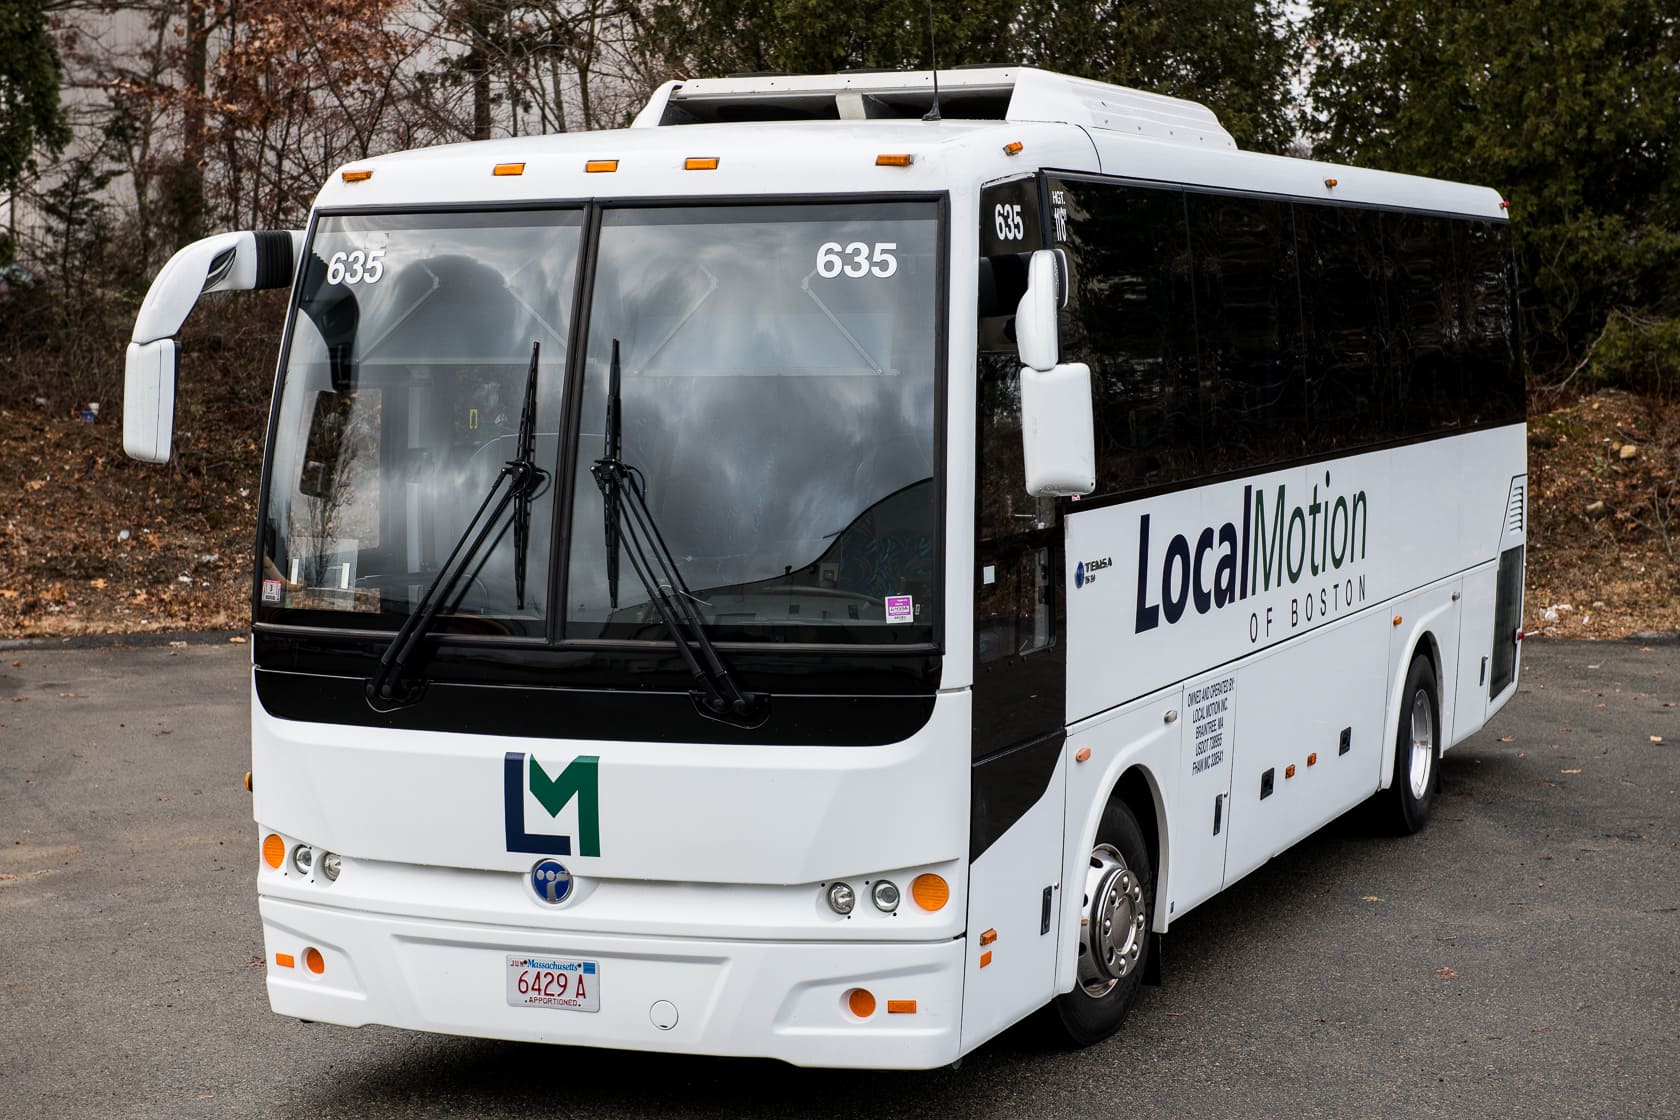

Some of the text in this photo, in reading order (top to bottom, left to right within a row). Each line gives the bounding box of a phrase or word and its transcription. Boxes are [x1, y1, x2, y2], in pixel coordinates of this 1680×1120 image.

[995, 203, 1024, 240] 635
[327, 250, 386, 285] 635
[816, 241, 898, 278] 635
[1085, 556, 1113, 573] TEMSA
[1135, 470, 1367, 634] LocalMotion
[1250, 574, 1366, 643] OF BOSTON
[1187, 689, 1202, 707] OWNED
[1202, 686, 1210, 702] AND
[1210, 679, 1229, 699] OPERATED
[1192, 706, 1205, 723] LOCAL
[1205, 700, 1220, 718] MOTION
[1217, 715, 1224, 730] MA
[1195, 738, 1209, 757] USDOT
[1203, 755, 1210, 770] MC
[504, 752, 600, 857] LM
[527, 959, 578, 971] Massachusetts
[518, 970, 587, 999] 6429 A
[528, 996, 578, 1007] APPORTIONED
